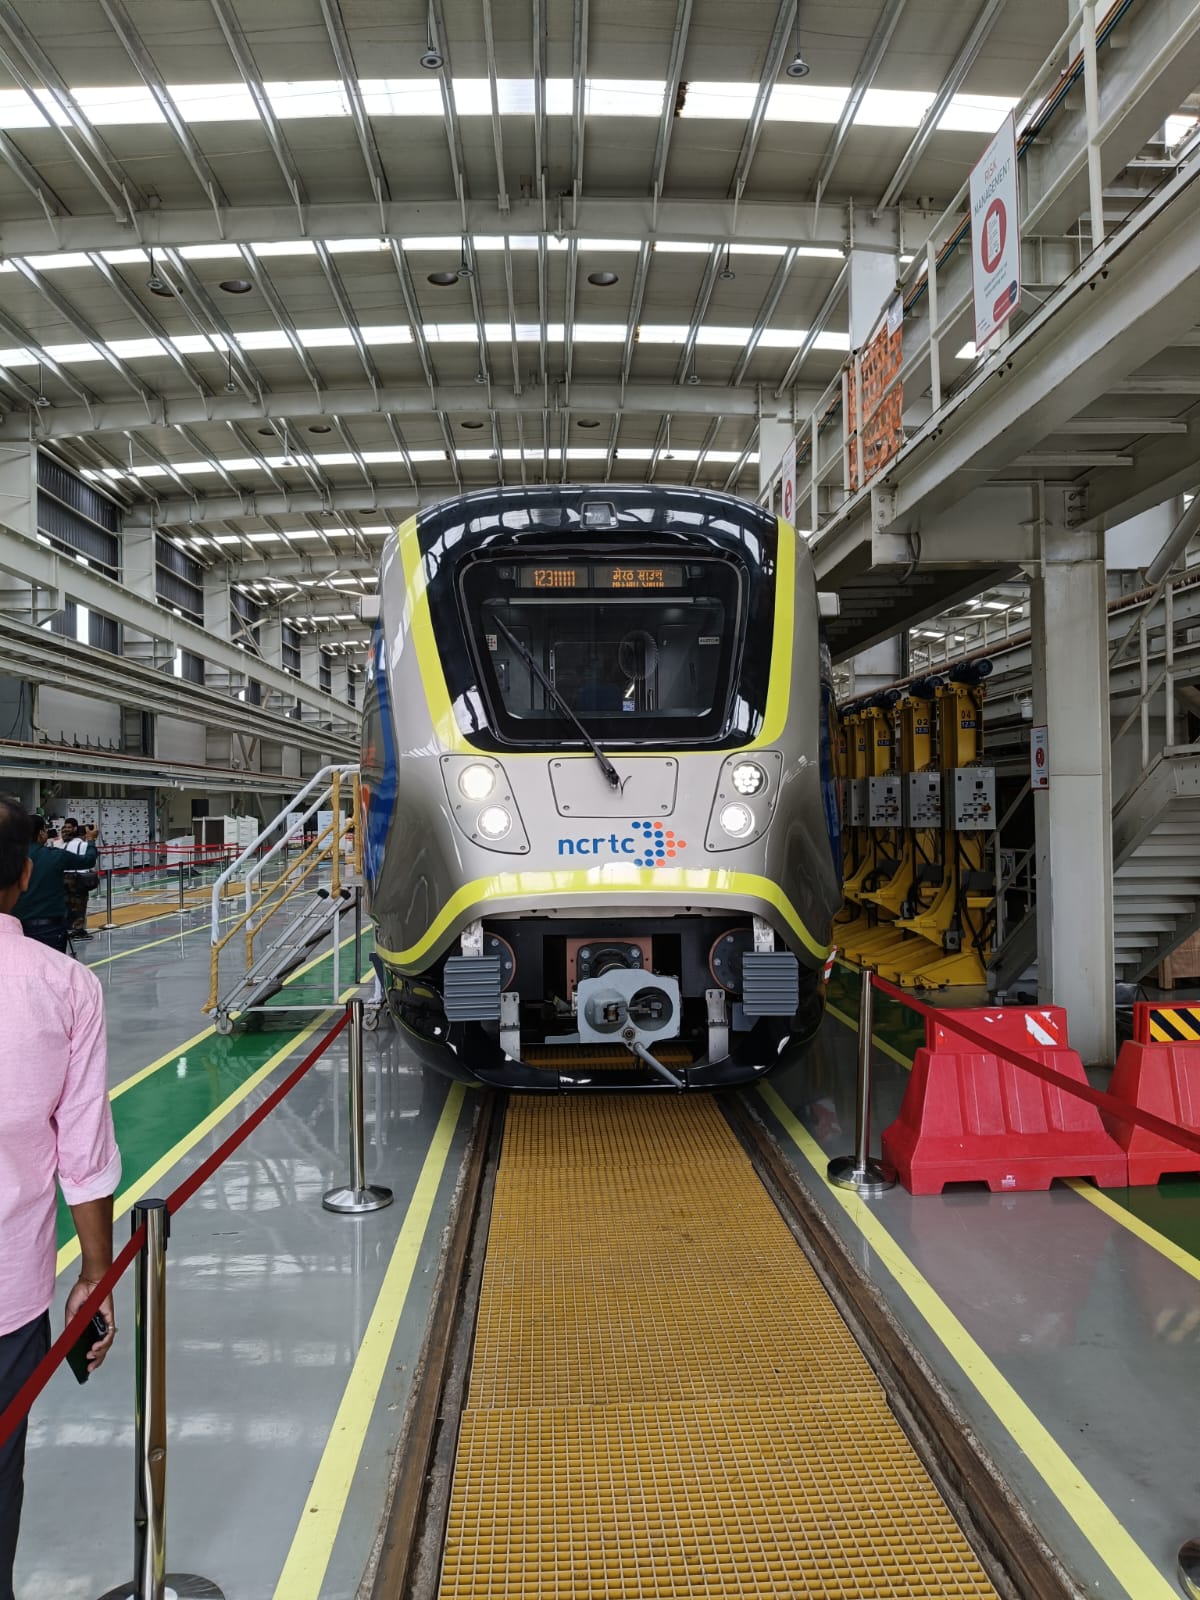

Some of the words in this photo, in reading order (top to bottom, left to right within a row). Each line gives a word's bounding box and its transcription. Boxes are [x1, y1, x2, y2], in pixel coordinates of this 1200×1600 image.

[984, 158, 999, 185] RISK
[974, 157, 1011, 217] MANAGEMENT
[612, 567, 635, 581] मेरठ
[558, 834, 635, 855] ncrtc
